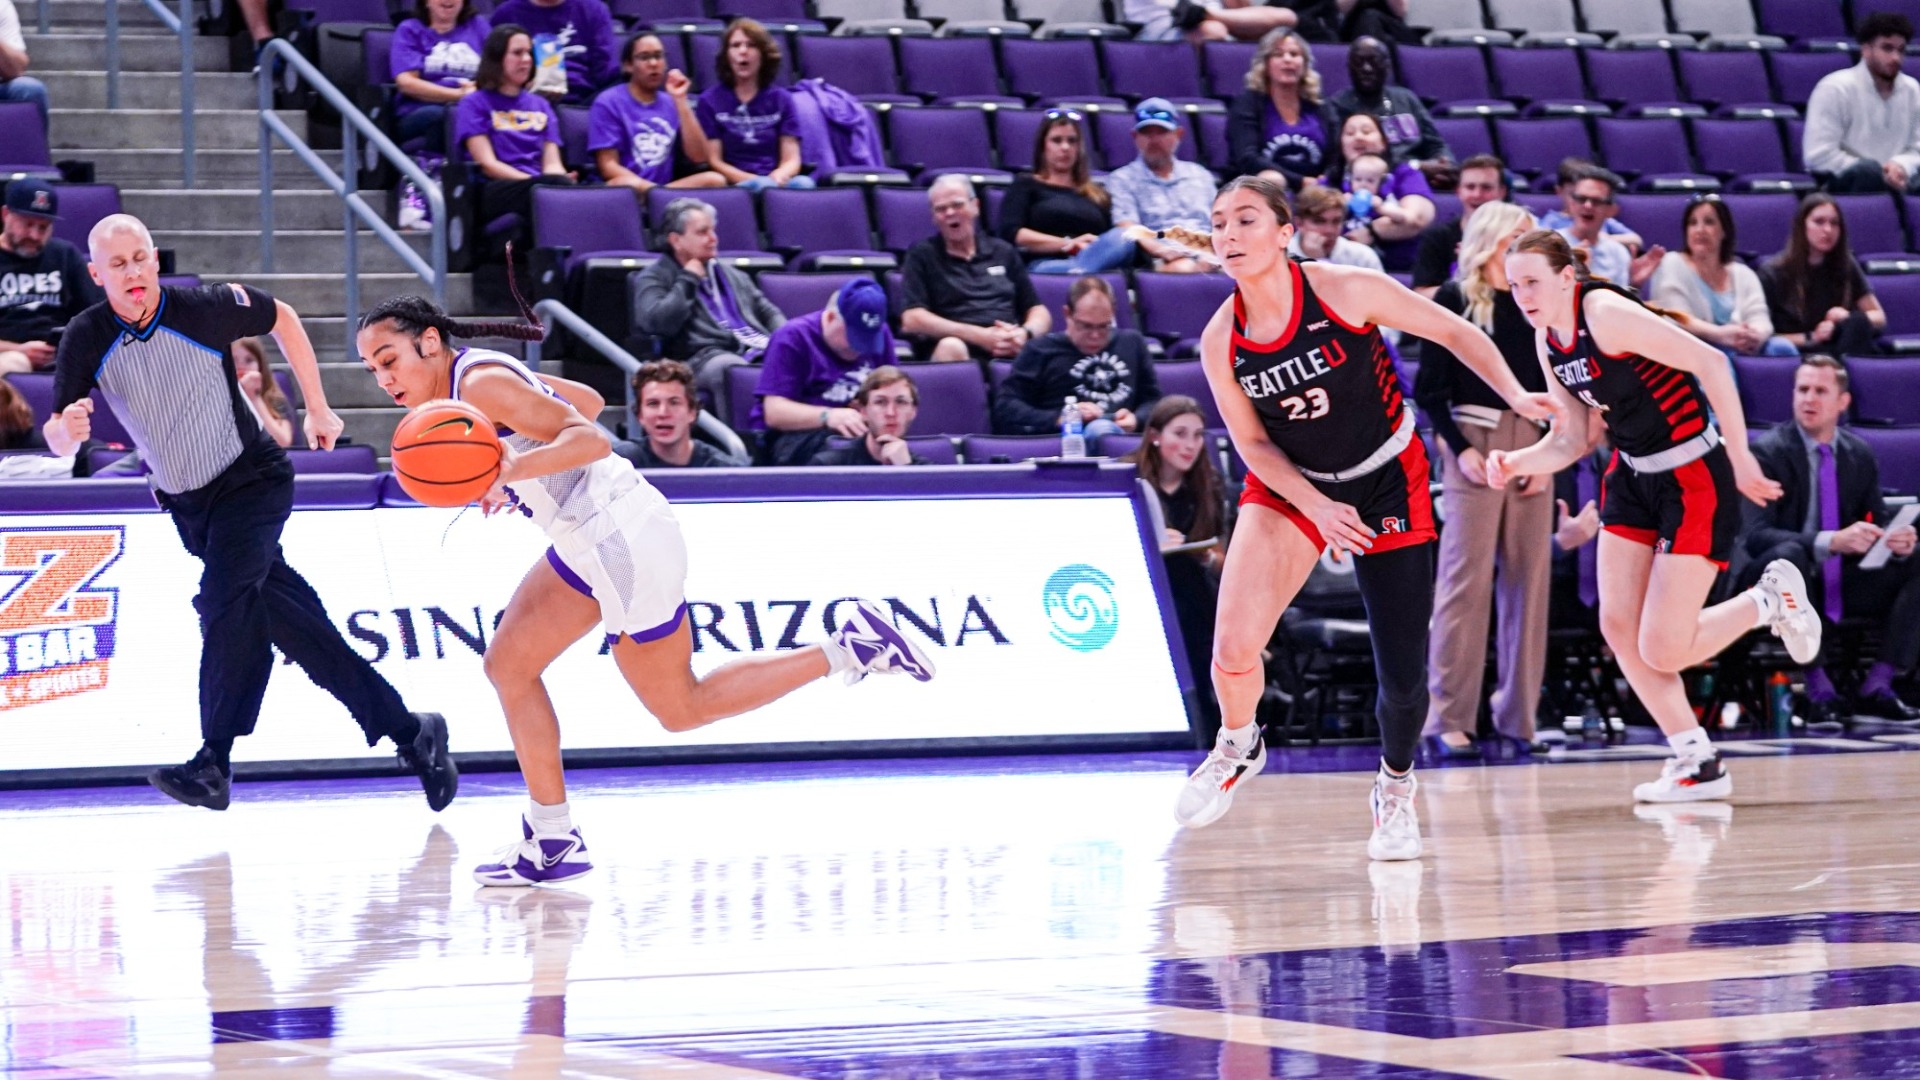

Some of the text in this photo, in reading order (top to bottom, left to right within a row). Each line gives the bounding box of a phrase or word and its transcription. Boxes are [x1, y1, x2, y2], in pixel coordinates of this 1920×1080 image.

[0, 270, 62, 295] OPES
[1280, 387, 1331, 420] 23
[597, 594, 1014, 656] RIZONA
[16, 626, 97, 674] BAR
[27, 666, 101, 698] SPIRITS
